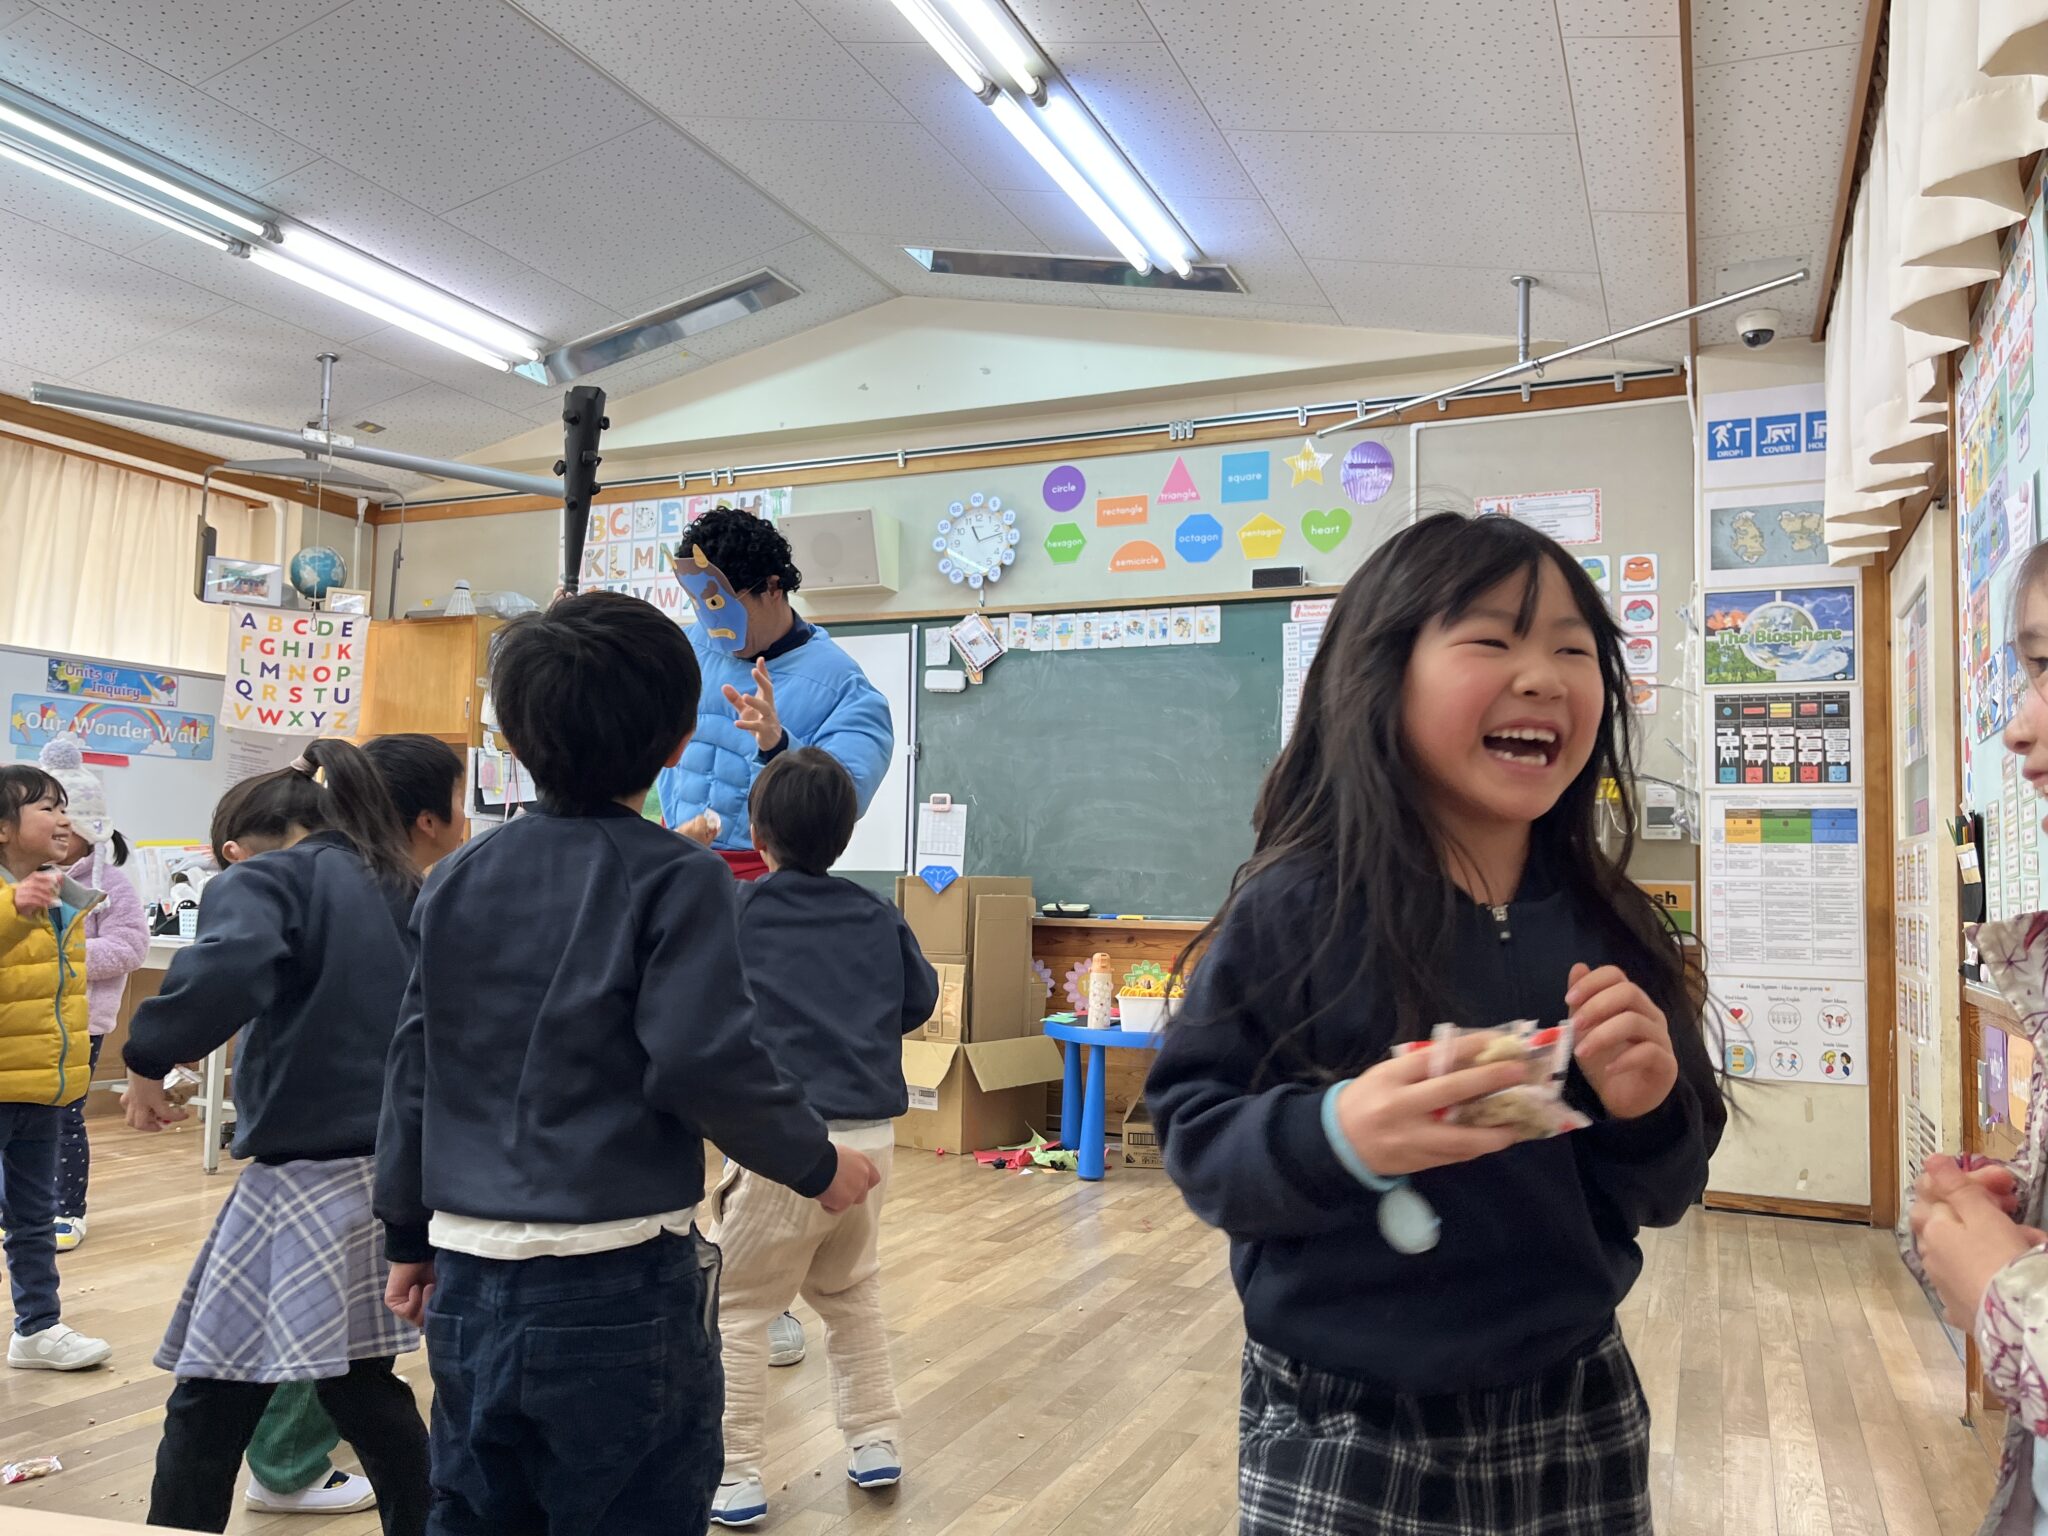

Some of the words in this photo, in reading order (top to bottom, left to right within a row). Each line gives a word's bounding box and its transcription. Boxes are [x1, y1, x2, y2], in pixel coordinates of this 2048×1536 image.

[1762, 444, 1795, 454] COVER!
[1808, 442, 1827, 450] HOL
[1716, 449, 1744, 458] DROP!
[1227, 472, 1262, 484] square
[1051, 482, 1077, 494] circle
[1160, 488, 1198, 502] triangle
[1102, 504, 1143, 516] rectangle
[609, 507, 631, 537] C
[635, 506, 657, 533] D
[660, 502, 683, 534] E
[993, 524, 1000, 532] 2
[1241, 528, 1283, 539] pentagon
[1310, 524, 1341, 535] heart
[1046, 538, 1083, 549] hexagon
[1178, 533, 1219, 545] octagon
[584, 548, 605, 578] K
[609, 545, 627, 579] L
[634, 546, 654, 571] M
[659, 542, 681, 573] N
[985, 557, 992, 565] 5
[1115, 555, 1160, 567] semicircle
[657, 587, 681, 609] W
[240, 613, 257, 629] A
[268, 615, 282, 632] B
[293, 619, 308, 635] C
[317, 620, 333, 636] D
[342, 621, 353, 637] E
[1717, 629, 1749, 645] The
[1754, 626, 1842, 647] Biosphere
[241, 635, 253, 652] F
[259, 638, 275, 655] G
[282, 640, 300, 658] H
[308, 642, 314, 659] I
[321, 643, 331, 659] J
[338, 643, 352, 660] K
[65, 663, 101, 680] Units
[105, 670, 118, 683] of
[240, 658, 250, 676] L
[260, 661, 280, 679] M
[288, 664, 306, 681] N
[313, 666, 331, 683] O
[337, 666, 351, 682] P
[91, 681, 141, 700] Inquiry
[236, 679, 253, 701] Q
[262, 684, 277, 701] R
[289, 687, 303, 703] S
[313, 688, 327, 704] T
[334, 687, 350, 704] U
[233, 703, 252, 721] V
[257, 707, 284, 726] W
[288, 710, 304, 727] X
[310, 711, 327, 727] Y
[333, 712, 348, 729] Z
[25, 711, 67, 731] Our
[73, 716, 152, 740] Wonder
[158, 724, 202, 744] Wall
[1653, 891, 1678, 905] sh
